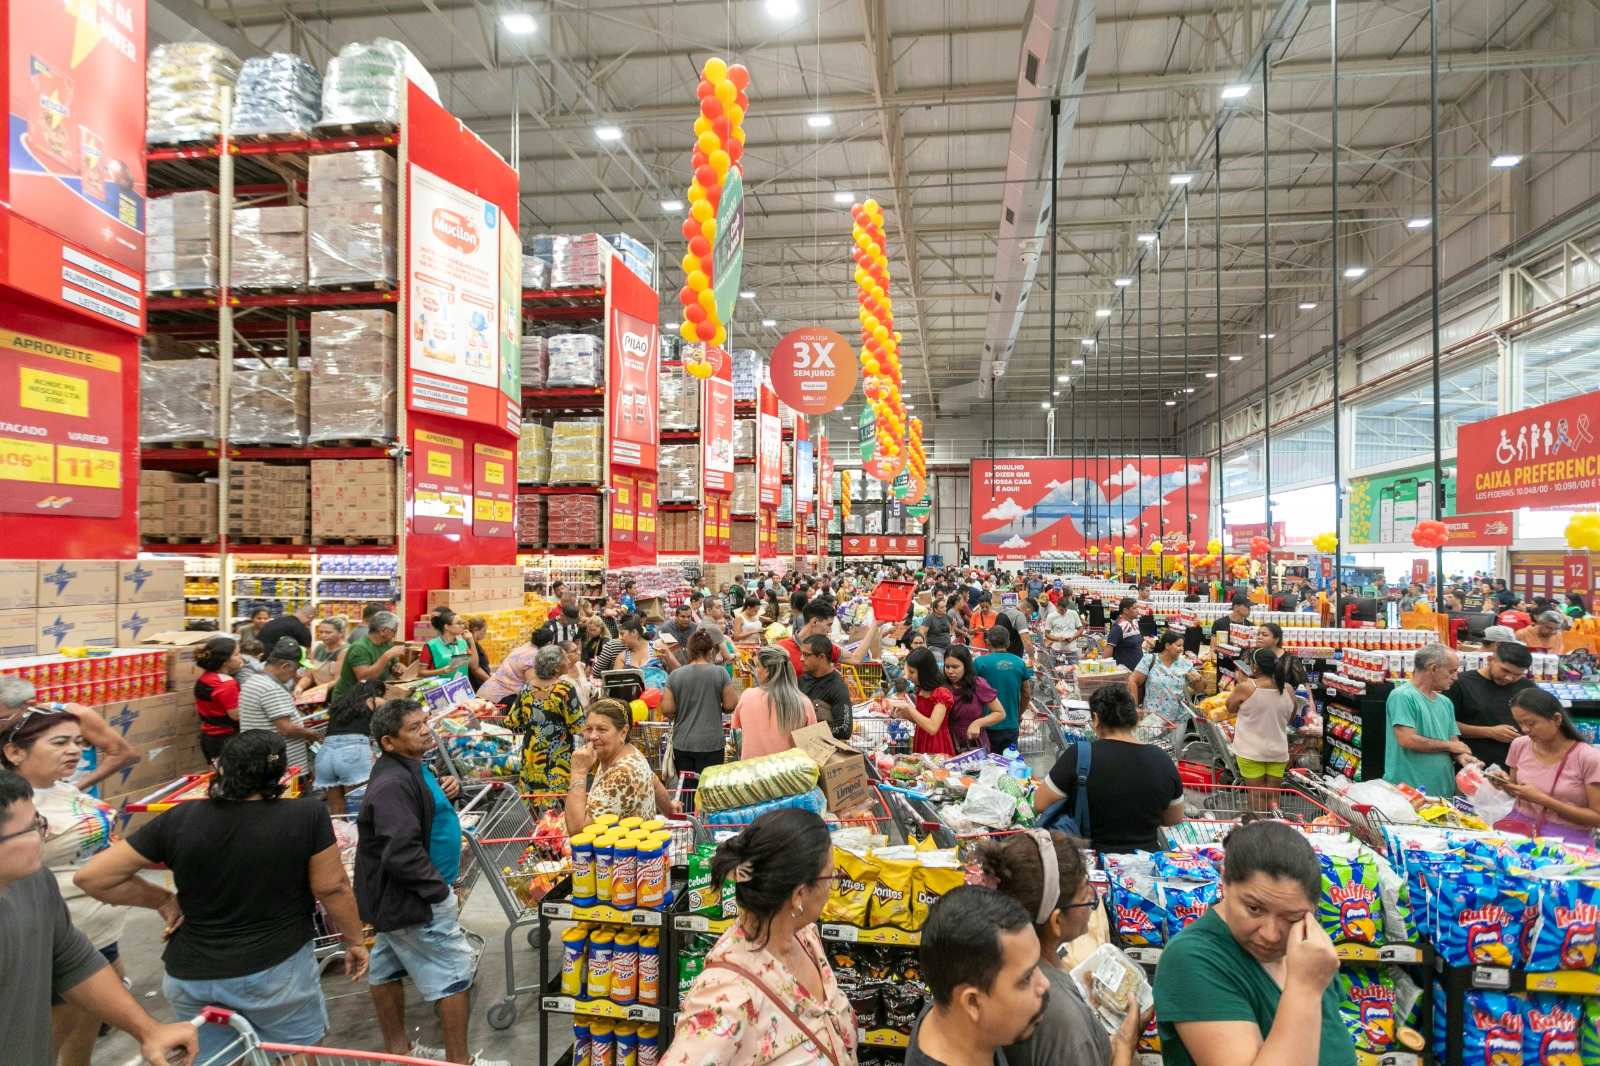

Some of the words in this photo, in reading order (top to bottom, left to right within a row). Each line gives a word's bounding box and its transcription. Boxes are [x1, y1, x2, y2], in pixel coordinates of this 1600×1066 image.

[434, 219, 477, 245] Mucilon
[13, 337, 93, 363] APROVEITE
[793, 341, 836, 369] 3X
[793, 369, 810, 377] SEM
[810, 369, 835, 378] JUROS
[1475, 469, 1512, 491] CAIXA
[1569, 564, 1584, 577] 12
[688, 873, 712, 888] Ceboli
[1328, 880, 1377, 904] Ruffles
[1458, 903, 1514, 928] Ruffles
[1554, 899, 1600, 928] Ruffl
[1350, 982, 1397, 1002] Ruffles
